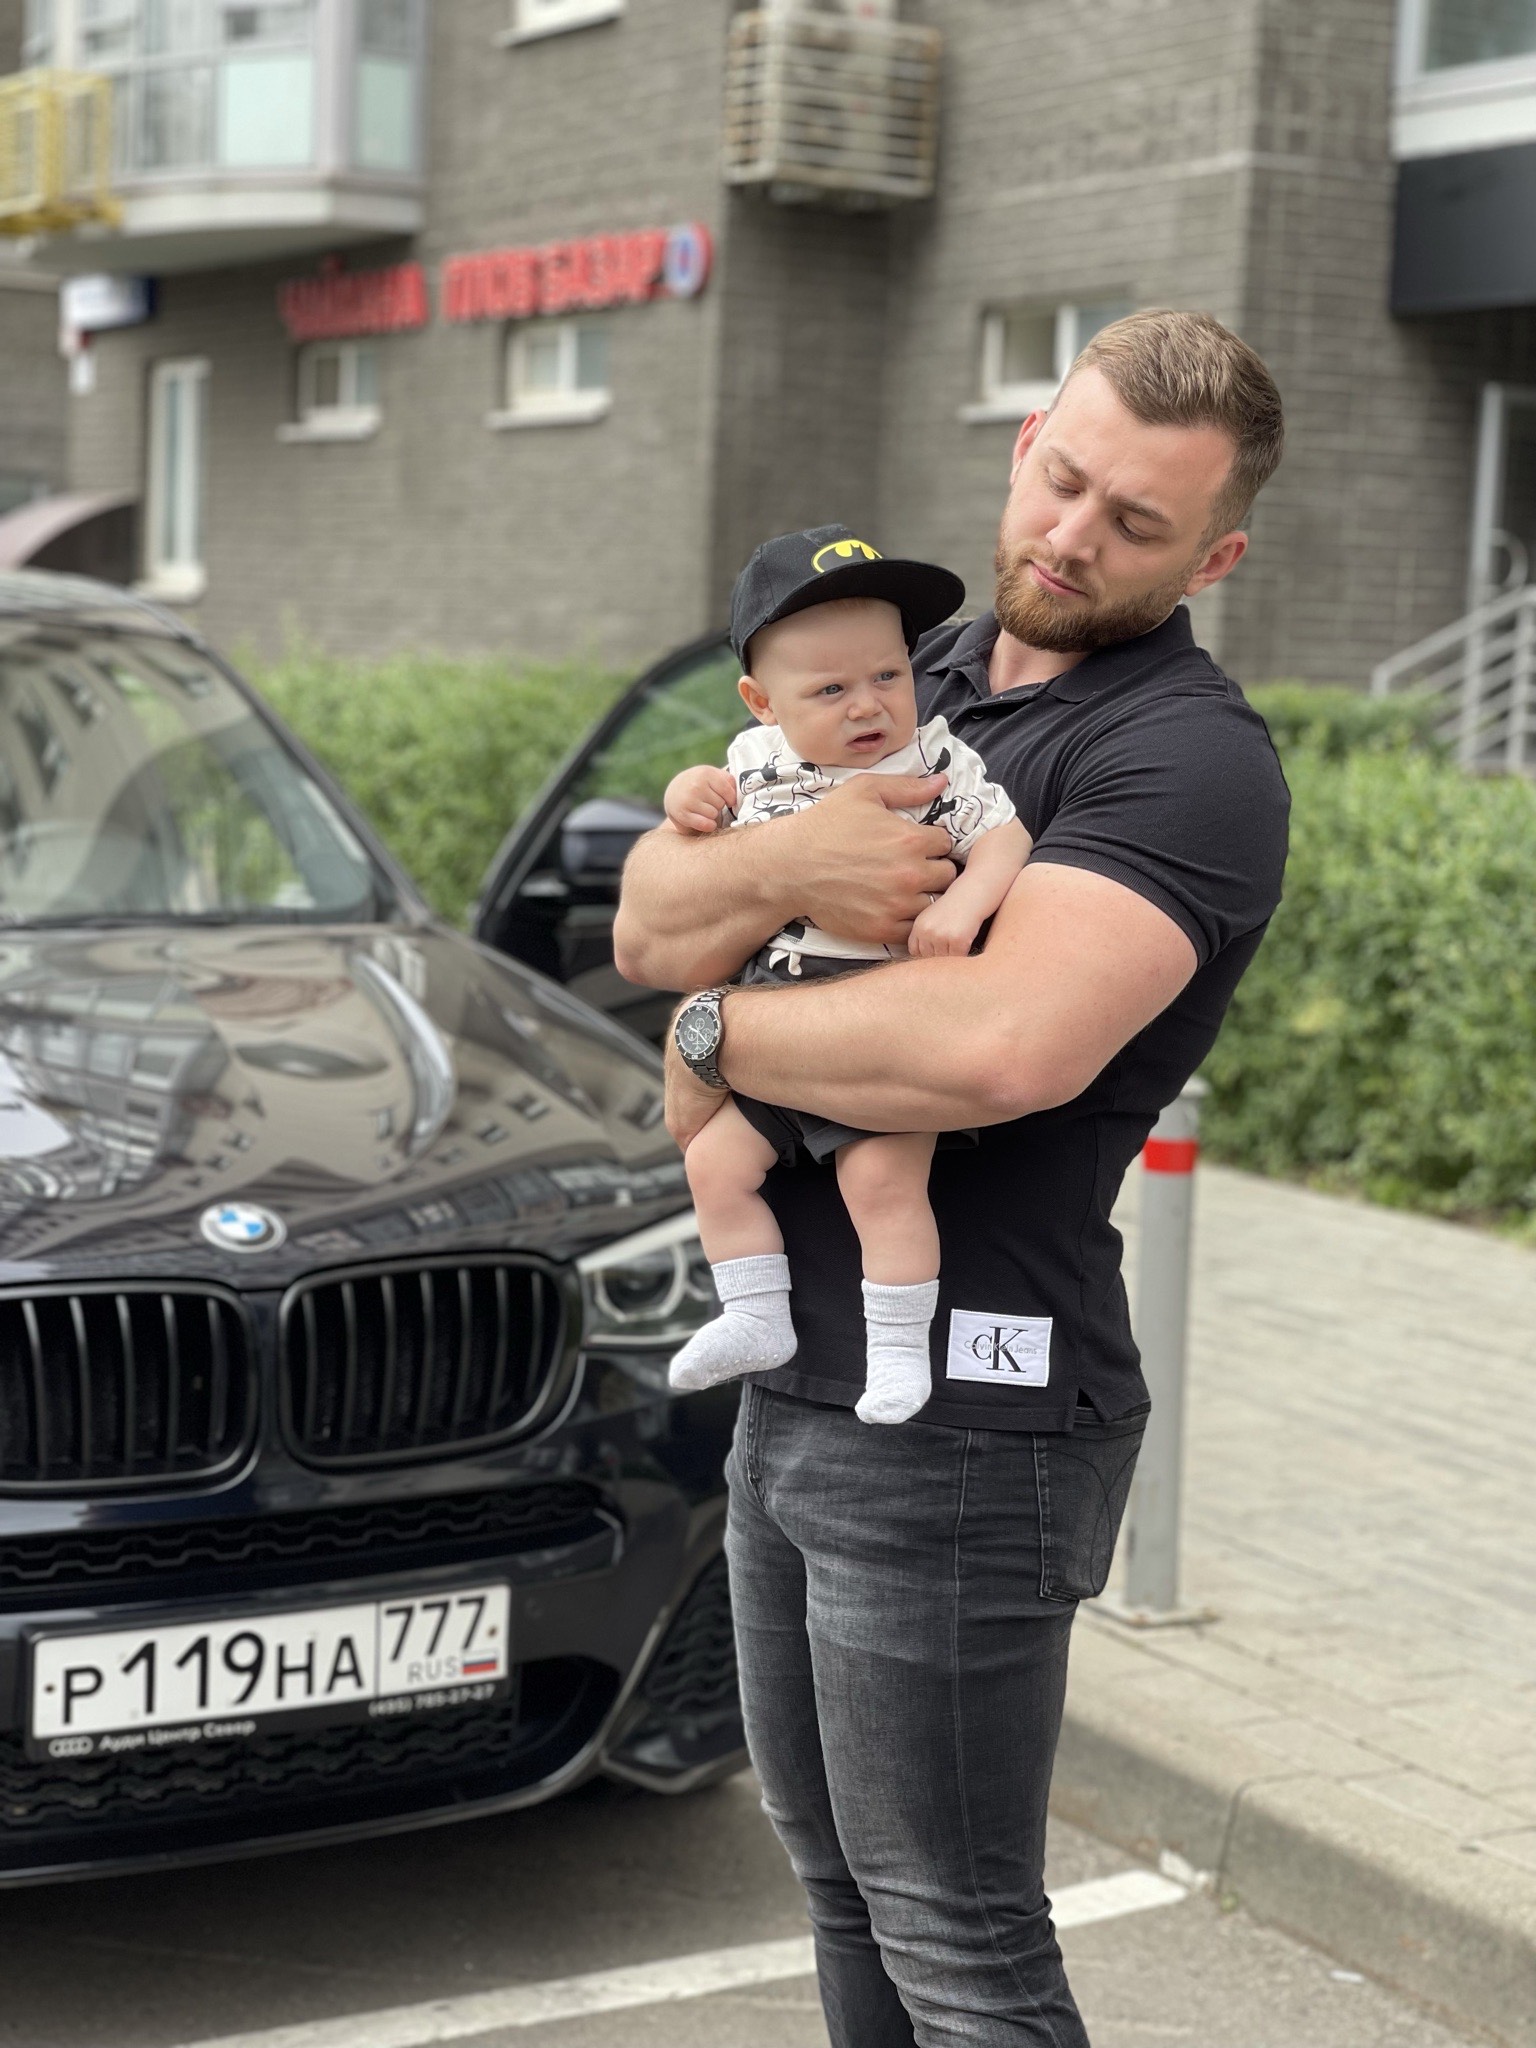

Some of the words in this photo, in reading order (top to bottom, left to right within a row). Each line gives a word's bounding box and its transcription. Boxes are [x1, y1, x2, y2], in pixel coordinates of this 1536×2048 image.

[1014, 1345, 1037, 1355] Jeans
[386, 1596, 485, 1662] 777
[407, 1656, 459, 1683] RUS
